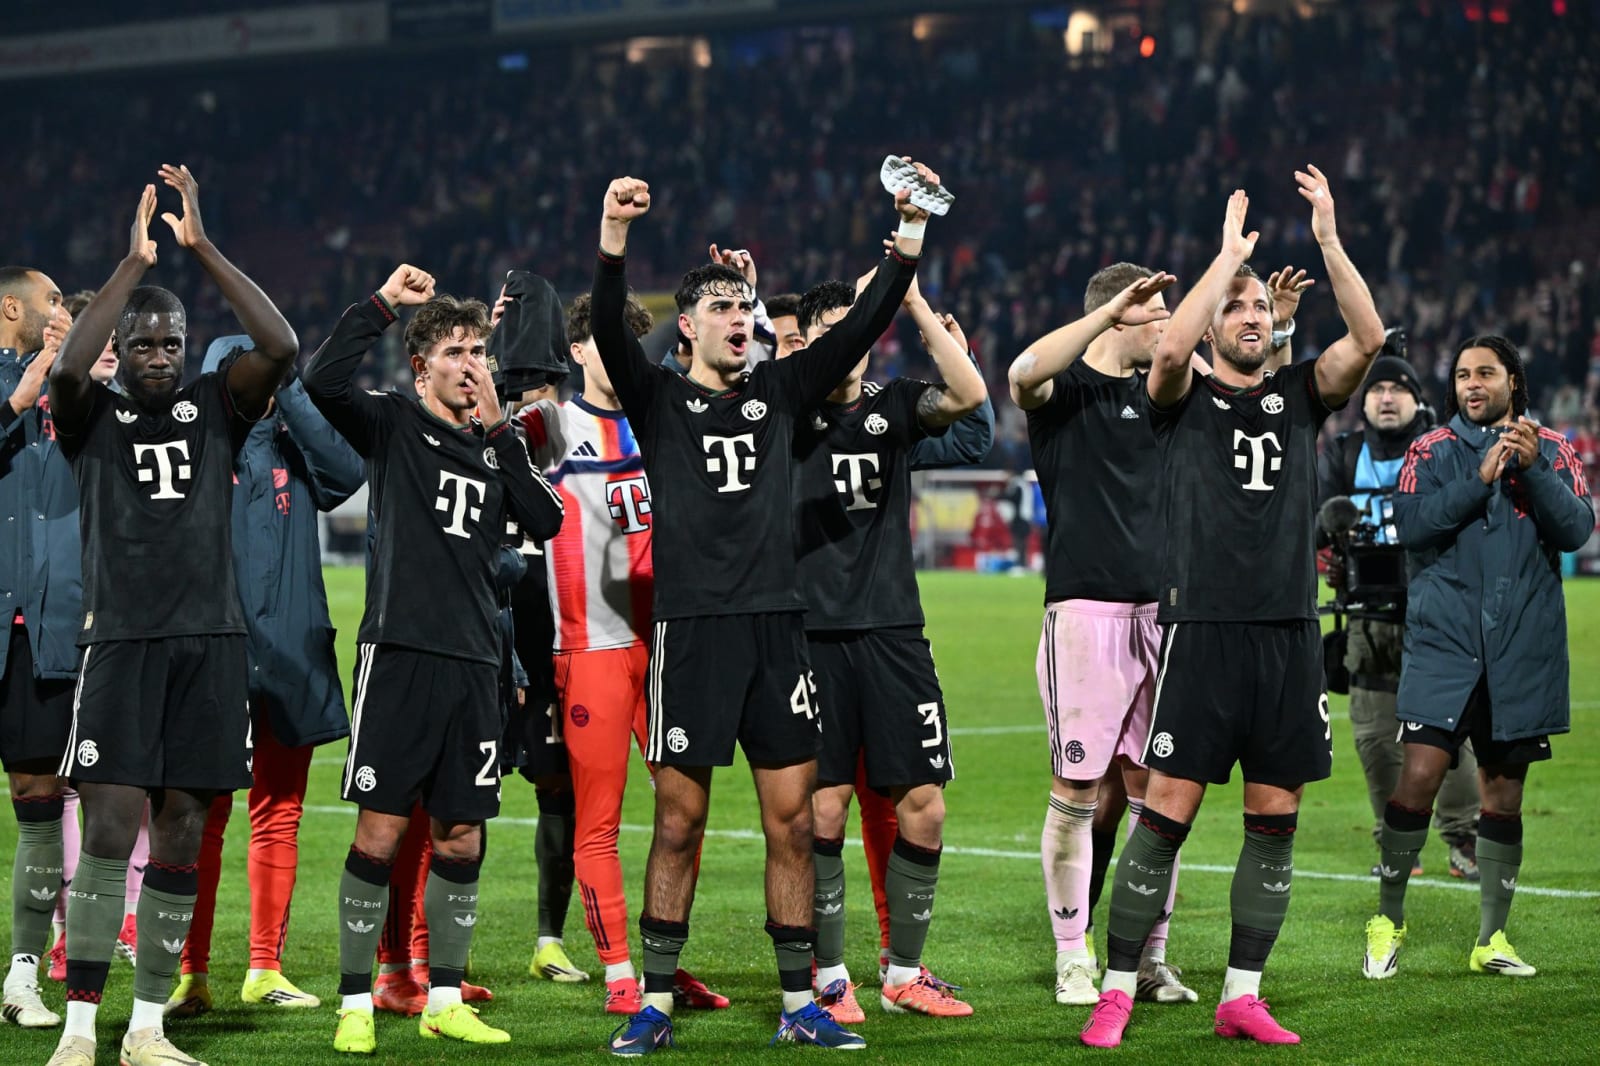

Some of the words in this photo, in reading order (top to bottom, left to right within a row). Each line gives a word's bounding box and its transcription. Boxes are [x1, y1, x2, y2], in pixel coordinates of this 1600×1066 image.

[134, 440, 191, 499] T
[702, 434, 755, 492] T
[832, 453, 882, 511] T
[1234, 430, 1282, 491] T
[435, 470, 486, 539] T
[606, 477, 652, 534] T
[917, 702, 943, 748] 3
[475, 740, 501, 786] 2
[344, 896, 382, 909] FCBM
